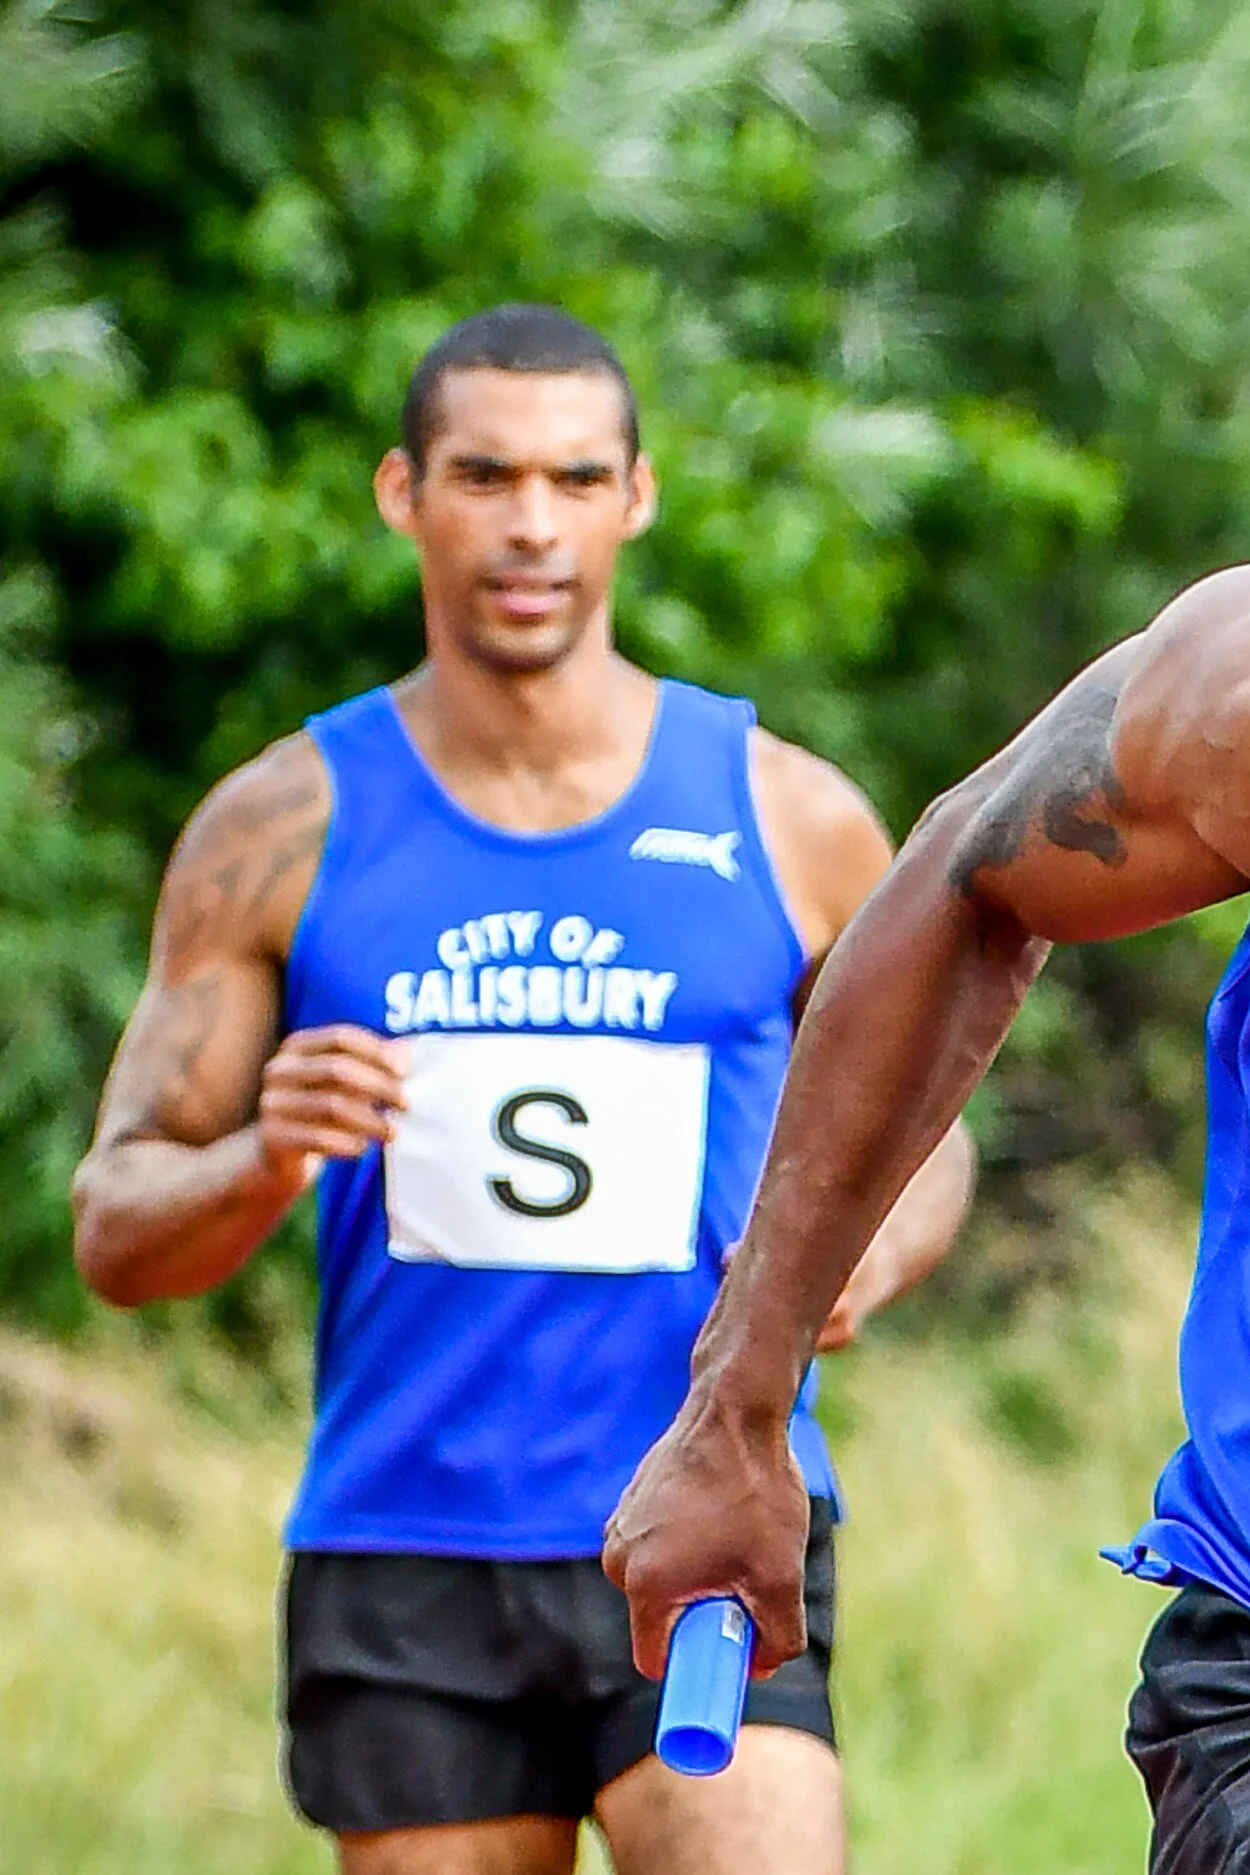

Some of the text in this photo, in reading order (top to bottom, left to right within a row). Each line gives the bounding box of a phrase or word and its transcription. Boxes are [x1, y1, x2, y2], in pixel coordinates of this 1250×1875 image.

[437, 910, 626, 969] CITY OF
[384, 966, 679, 1033] SALISBURY
[491, 1091, 594, 1218] S
